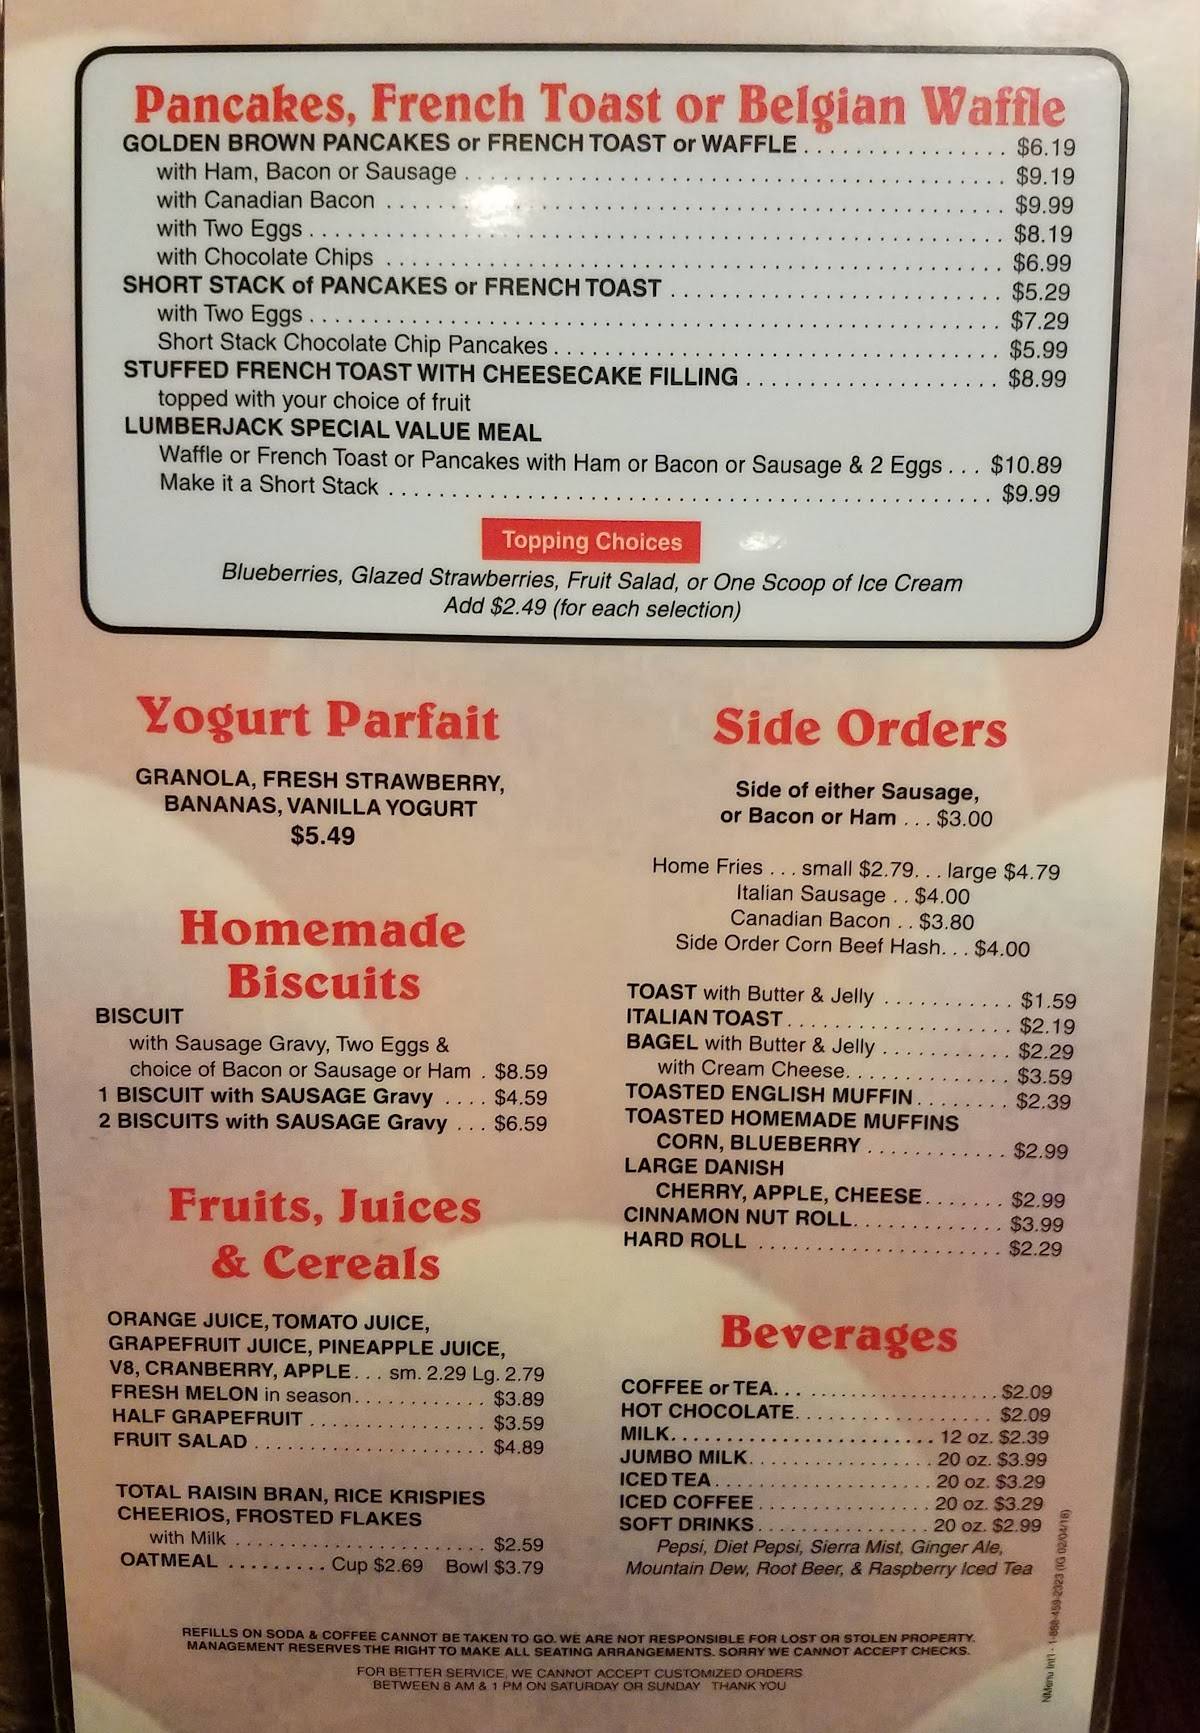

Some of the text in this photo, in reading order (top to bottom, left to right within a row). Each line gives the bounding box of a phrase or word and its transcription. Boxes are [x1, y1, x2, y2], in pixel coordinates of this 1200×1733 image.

[135, 82, 1064, 134] Pancakes, French Toast or Belgian Waffle
[122, 132, 1076, 159] GOLDEN BROWN PANCAKES or FRENCH TOAST or WAFFLE $6.19
[156, 246, 1072, 275] with Chocolate Chips $6.99
[158, 331, 1068, 361] Short Stack Chocolate Chip Pancakes $5.99
[157, 388, 471, 413] topped with your choice of fruit
[125, 416, 543, 443] LUMBERJACK SPECIAL VALUE MEAL
[160, 472, 1061, 505] Make it a Short Stack $9.99
[501, 528, 683, 556] Topping Choices
[443, 595, 742, 623] Add $2.49 (for each selection)
[136, 695, 500, 744] Yogurt Parfait
[713, 708, 1007, 747] Side Orders
[135, 767, 505, 796] GRANOLA, FRESH STRAWBERRY,
[735, 779, 979, 806] Side of either Sausage,
[164, 794, 478, 818] BANANAS, VANILLA YOGURT
[720, 806, 993, 829] or Bacon or Ham $3.00
[290, 823, 356, 847] $5.49
[180, 909, 464, 948] Homemade
[730, 908, 975, 932] Canadian Bacon $3.80
[228, 964, 421, 1001] Biscuits
[626, 982, 1077, 1011] TOAST with Butter & Jelly $1.59
[95, 1007, 185, 1025] BISCUIT
[128, 1034, 450, 1057] with Sausage Gravy, Two Eggs &
[98, 1112, 548, 1135] 2 BISCUITS with SAUSAGE Gravy $6.59
[624, 1107, 960, 1132] TOASTED HOMEMADE MUFFINS
[656, 1132, 1069, 1161] CORN, BLUEBERRY $2.99
[168, 1187, 481, 1226] Fruits, Juices
[623, 1230, 1063, 1258] HARD ROLL $2.29
[210, 1244, 440, 1279] & Cereals
[107, 1310, 430, 1335] ORANGE JUICE, TOMATO JUICE,
[721, 1315, 958, 1359] Beverages
[112, 1407, 545, 1433] HALF GRAPEFRUIT $3.59
[621, 1425, 1050, 1446] MILK 12 oz. $2.39
[115, 1483, 486, 1506] TOTAL RAISIN BRAN, RICE KRISPIES
[619, 1493, 1044, 1513] ICED COFFEE 20 oz. $3.29
[120, 1551, 544, 1576] OATMEAL Cup $2.69 Bowl $3.79
[625, 1560, 1034, 1580] Mountain Dew, Root Beer, & Raspberry Iced Tea
[356, 1665, 386, 1678] FOR
[388, 1666, 443, 1679] BETTER
[510, 1668, 533, 1679] WE
[536, 1667, 594, 1680] CANNOT
[596, 1667, 651, 1680] ACCEPT
[653, 1667, 743, 1680] CUSTOMIZED
[744, 1667, 804, 1679] ORDERS
